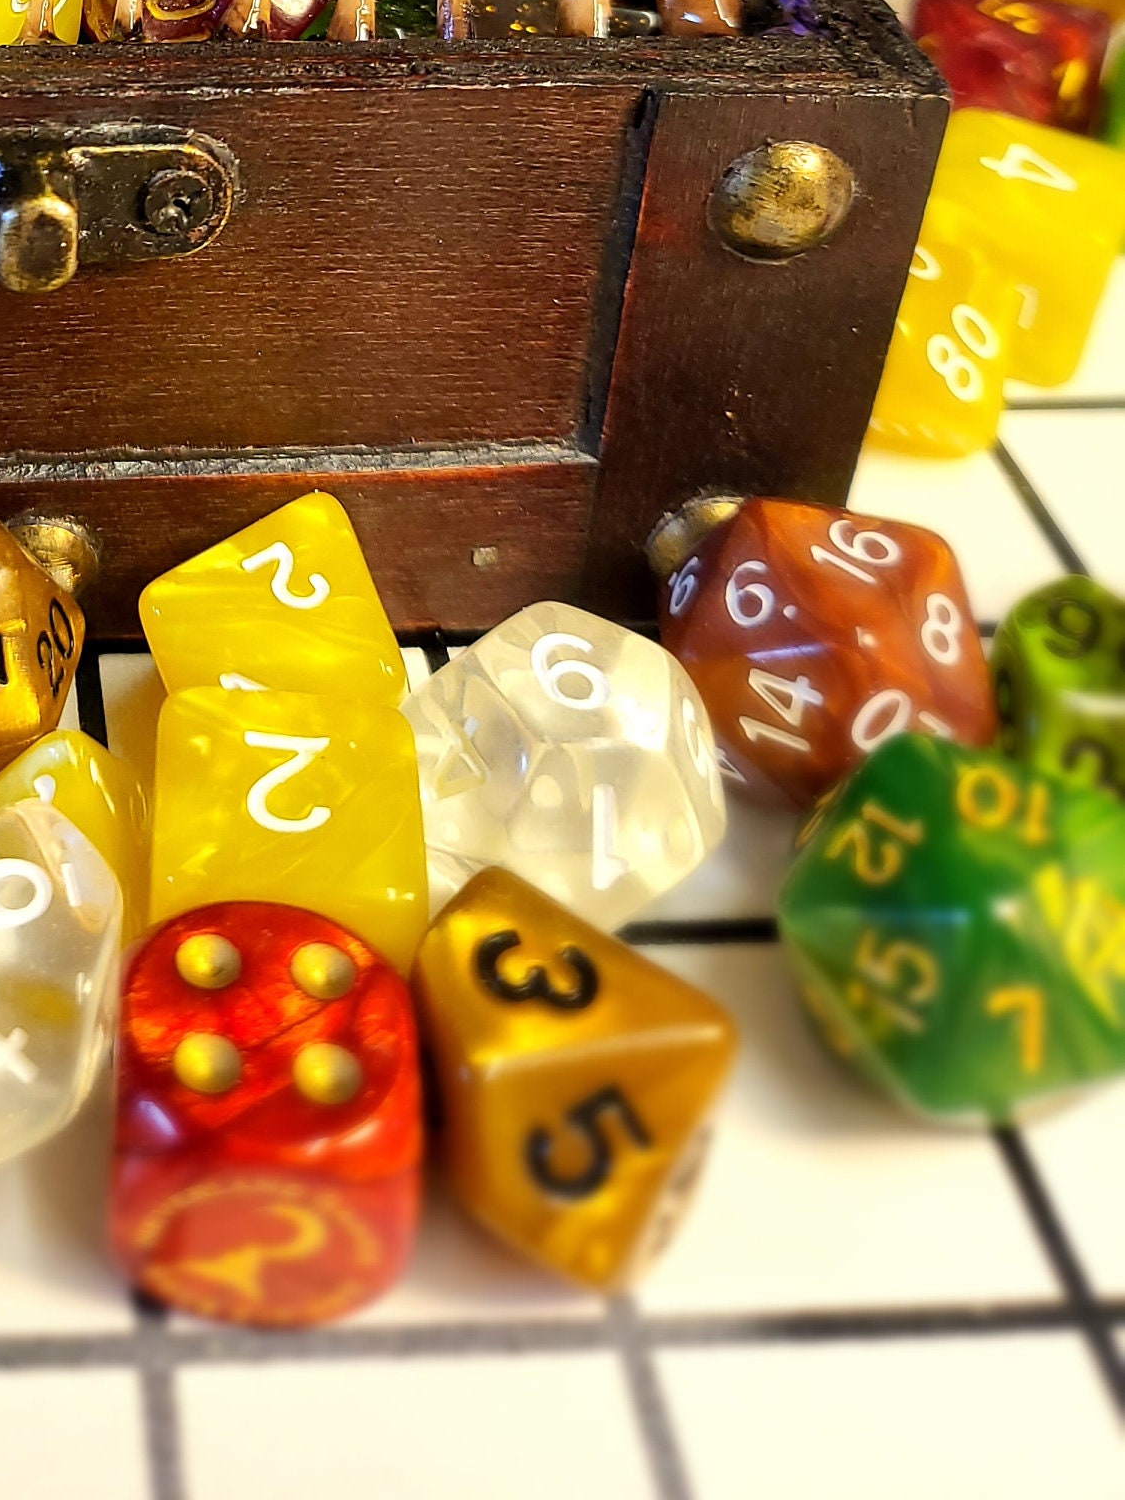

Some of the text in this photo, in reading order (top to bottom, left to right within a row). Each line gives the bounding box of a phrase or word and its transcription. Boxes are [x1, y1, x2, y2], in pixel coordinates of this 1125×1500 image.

[979, 141, 1079, 193] 4
[926, 302, 1002, 404] 80
[241, 540, 331, 610] 2
[809, 519, 903, 585] 16
[35, 596, 76, 699] 20
[920, 592, 963, 666] 8
[738, 667, 825, 752] 14
[243, 730, 332, 833] 2
[592, 783, 628, 892] 1
[473, 929, 601, 1018] 3
[986, 983, 1046, 1076] 7
[523, 1083, 655, 1202] 5
